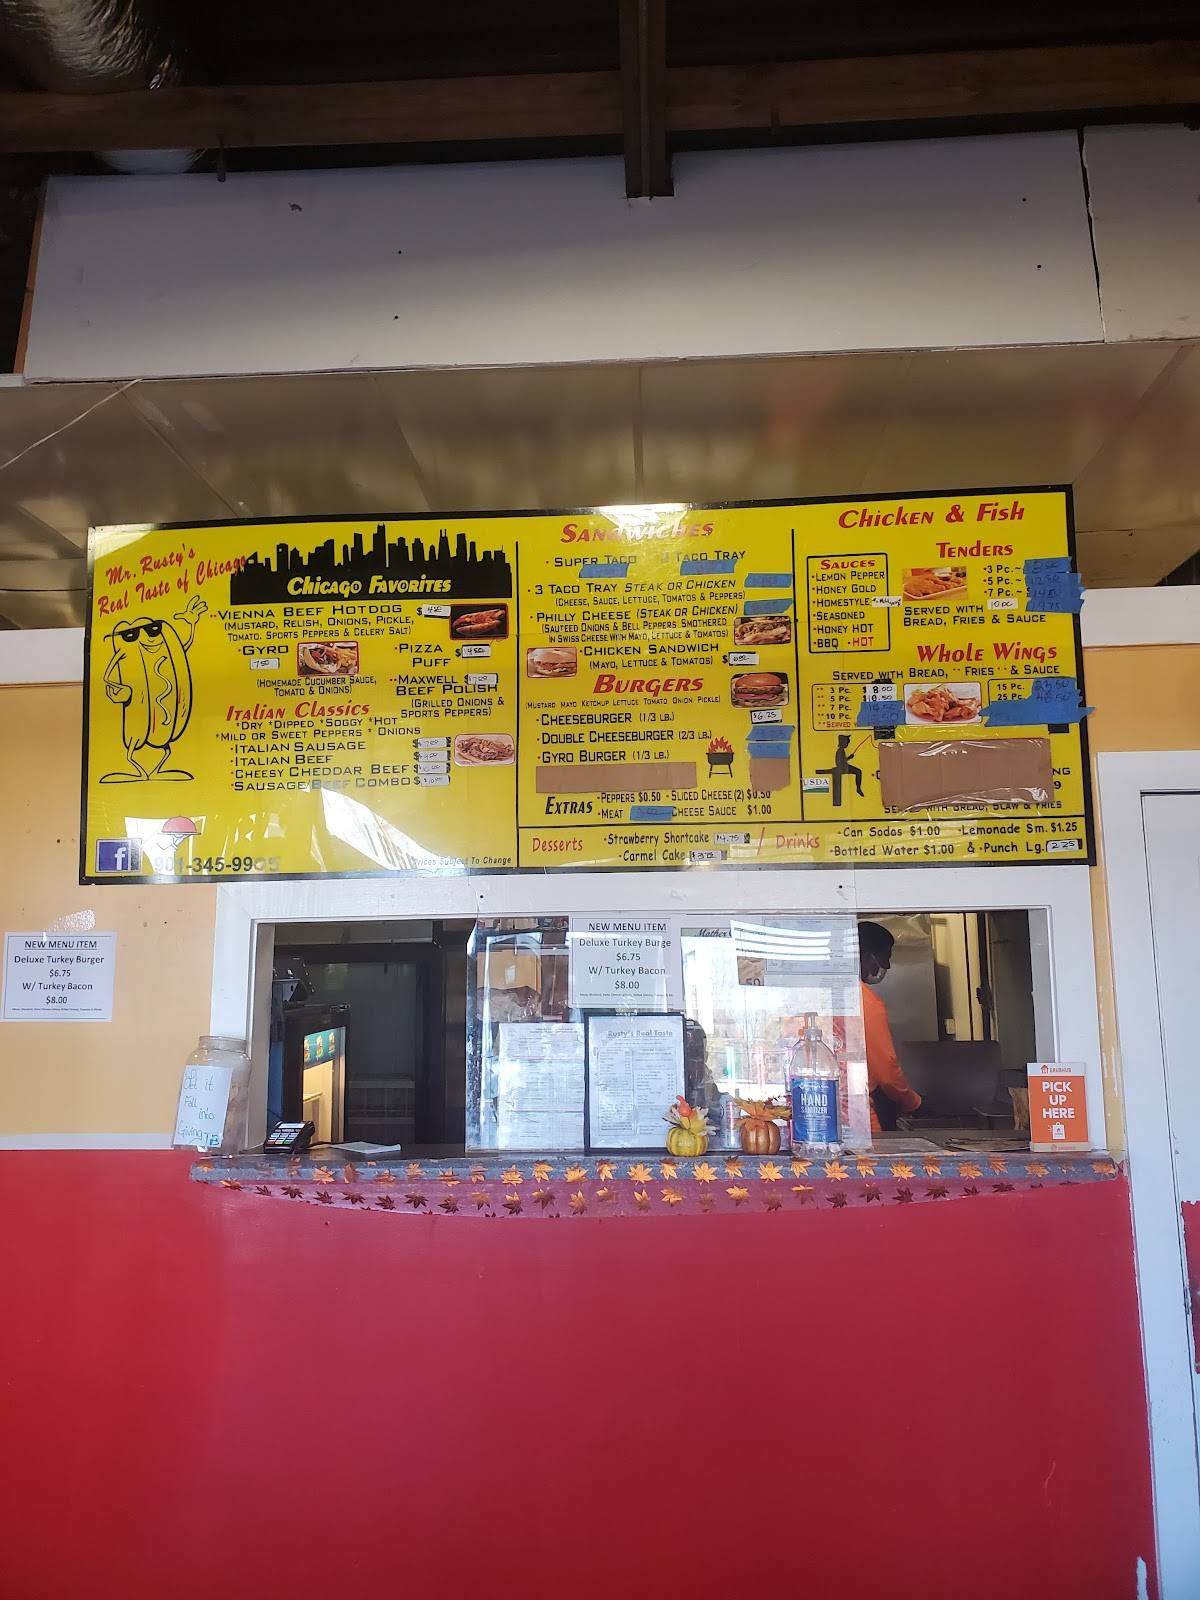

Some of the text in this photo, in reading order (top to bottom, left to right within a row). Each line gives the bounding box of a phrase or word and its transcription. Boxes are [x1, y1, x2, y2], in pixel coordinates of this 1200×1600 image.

[945, 504, 964, 523] &
[977, 501, 1025, 522] Fish
[105, 543, 196, 587] Mr. Rusty's
[820, 559, 876, 570] SAUCES
[815, 571, 885, 582] LEMON PEPPER
[97, 555, 247, 618] Real Taste of Chicago
[625, 579, 736, 592] STEAK CHICKEN
[816, 584, 877, 594] HONEY GOLD
[555, 590, 746, 607] (CHEESE, SAUCE, PEPPERS)
[816, 598, 871, 607] HOMESTYLE
[217, 604, 402, 620] VIENNA BEEF HOTDOG
[582, 604, 739, 620] CHEESE (STEAK CHICKEN)
[816, 611, 866, 620] SEASONED
[904, 605, 950, 615] SERVED
[224, 615, 414, 631] (MUSTARD, RELISH, ONIONS, PICKLE,
[541, 618, 727, 633] (SAUTEED SMOTHERED
[903, 616, 947, 627] BREAD,
[388, 625, 412, 636] SALT)
[852, 623, 874, 633] HOT
[853, 637, 874, 647] HOT
[242, 645, 289, 655] GYRO
[399, 644, 443, 654] PIZZA
[648, 643, 719, 654] SANDWICH
[916, 644, 984, 664] Whole
[412, 658, 451, 668] PUFF
[589, 660, 618, 670] (MAYO,
[832, 667, 949, 681] SERVED WITH BREAD,
[257, 675, 377, 687] (HOMEMADE SAUCE,
[398, 675, 458, 685] MAXWELL
[396, 686, 435, 696] BEEF
[411, 697, 494, 708] (GRILLED ONIONS
[444, 707, 492, 718] PEPPERS)
[541, 712, 675, 726] CHEESEBURGER (1/3 LB.)
[272, 728, 362, 740] SWEET PEPPERS
[541, 730, 695, 744] DOUBLE CHEESEBURGER (2/3
[234, 741, 366, 754] ITALIAN SAUSAGE
[541, 749, 670, 764] GYRO BURGER (1/3 LB.)
[235, 766, 363, 779] CHEESY CHEDDAR
[356, 777, 411, 787] COMBO
[600, 790, 733, 803] PEPPERS $0.50 SLICED CHEESE
[545, 796, 593, 815] EXTRAS
[709, 804, 772, 816] SAUCE $1.00
[601, 809, 623, 819] MEAT
[843, 822, 1078, 837] Can Sodas $1.00 Lemonade $1.25
[532, 837, 583, 852] Desserts
[608, 831, 710, 850] Strawberry Shortcake
[776, 835, 820, 850] Drinks
[623, 850, 657, 862] Carmel
[662, 849, 686, 860] Cake
[833, 843, 1045, 857] Bottled Water $1.00 Punch Lg.
[440, 857, 468, 866] Subject
[483, 856, 512, 865] Change
[588, 921, 666, 932] NEW MENU ITEM
[25, 940, 97, 949] NEW MENU ITEM
[579, 938, 610, 948] Deluxe
[612, 938, 643, 950] Turkey
[14, 955, 105, 966] Deluxe Turkey Burger
[616, 952, 641, 962] $6.75
[49, 969, 71, 978] $6.75
[588, 965, 666, 978] W/ Turkey Bacon
[22, 982, 93, 992] W/ Turkey Bacon
[614, 980, 640, 990] $8.00
[46, 995, 68, 1004] $8.00
[1042, 1082, 1072, 1092] PICK
[801, 1094, 828, 1106] HAND
[1049, 1095, 1067, 1105] UP
[1043, 1108, 1075, 1118] HERE
